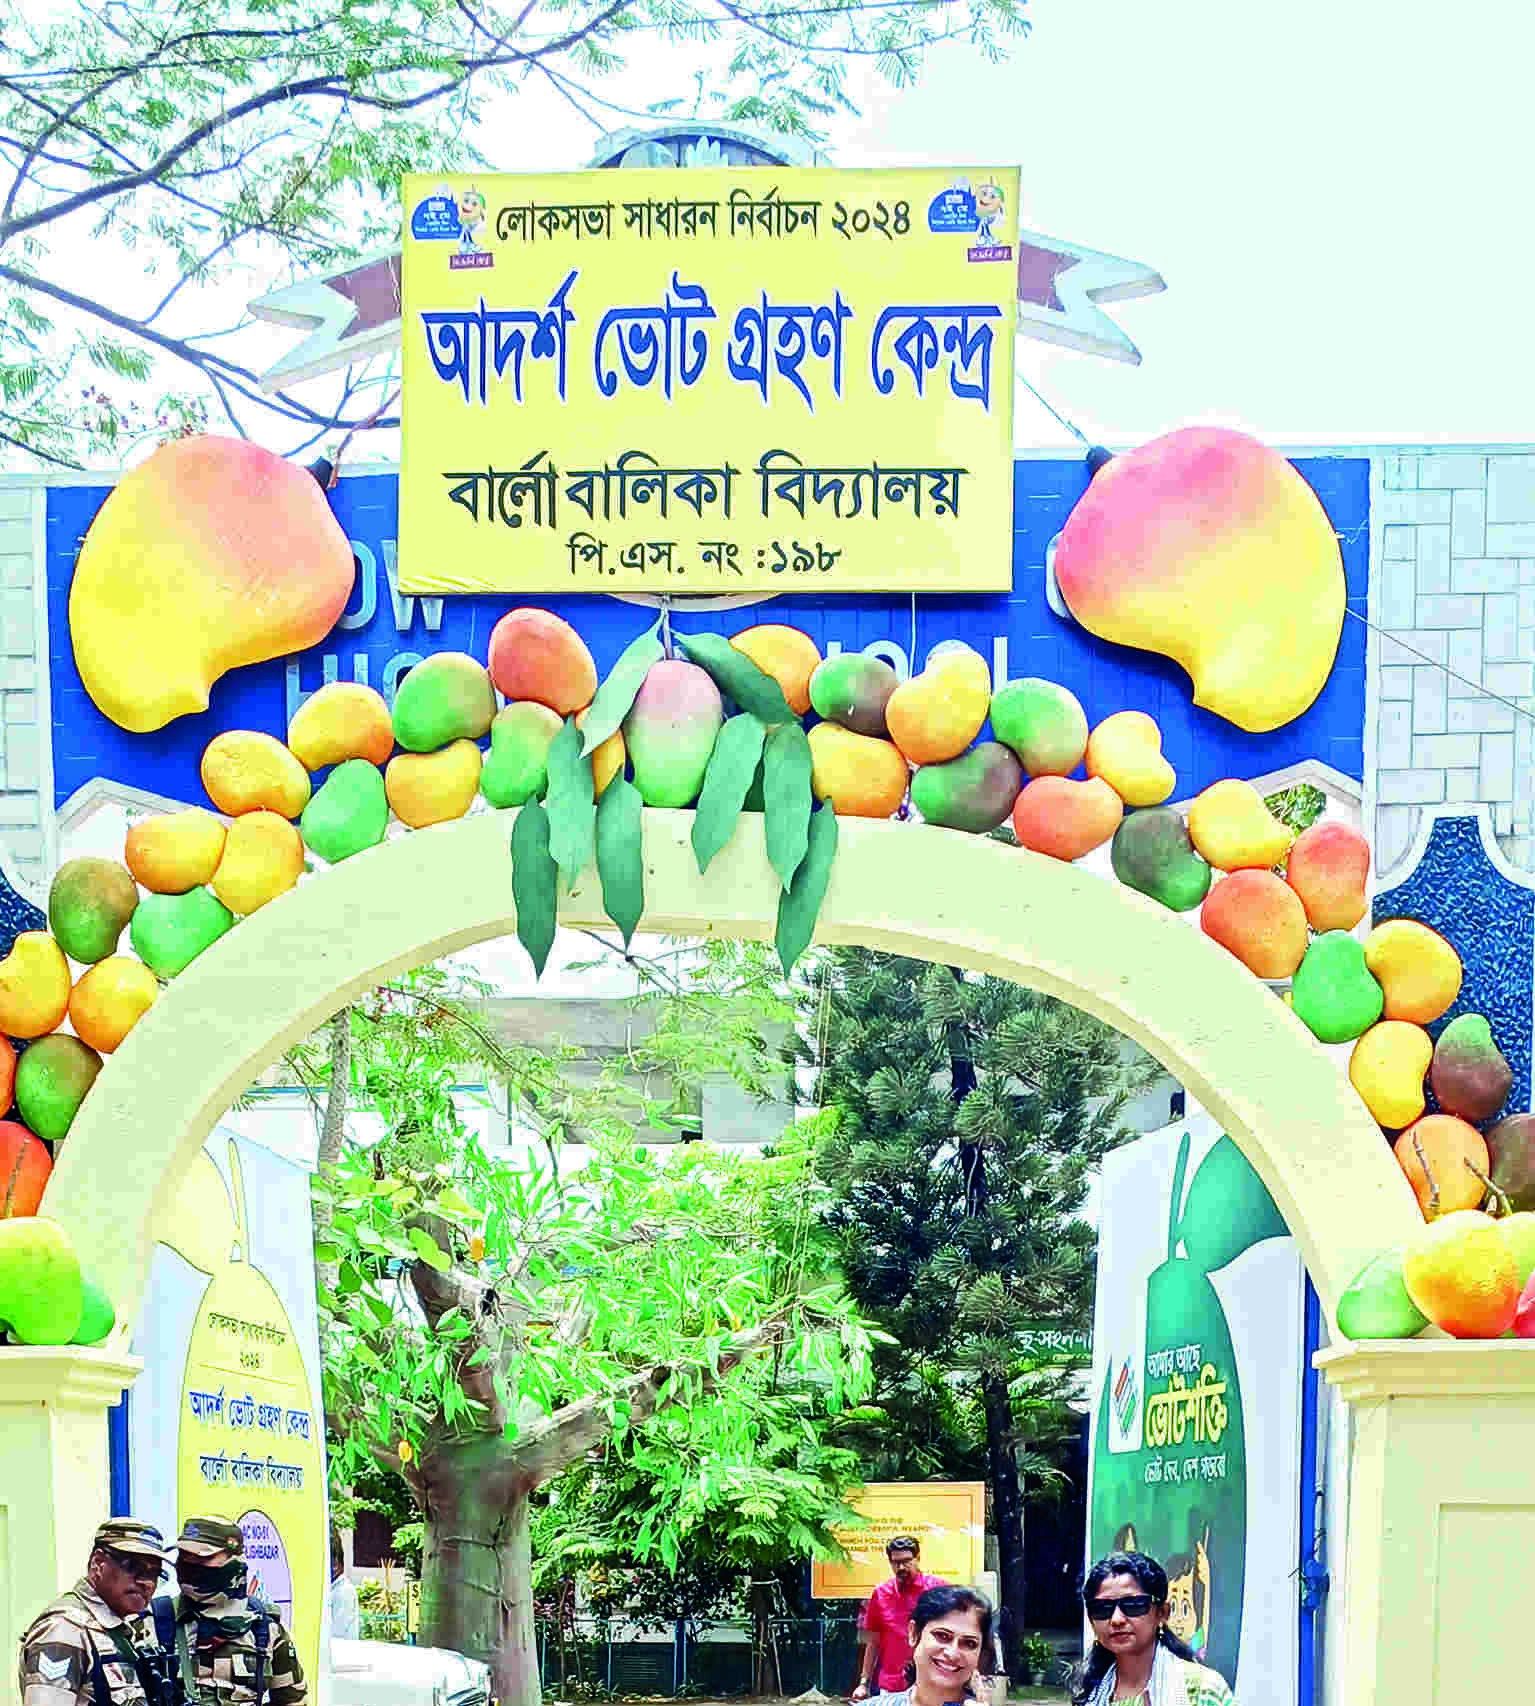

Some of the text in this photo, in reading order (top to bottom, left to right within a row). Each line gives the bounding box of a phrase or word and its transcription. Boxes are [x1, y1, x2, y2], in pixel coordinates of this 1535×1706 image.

[496, 199, 616, 241] লোকসভা
[621, 198, 718, 241] সাধারন
[727, 187, 823, 239] নির্বাচন
[831, 200, 911, 240] ২০২৪
[420, 269, 1002, 412] আদর্শ ভোট গ্রহণ কেন্দ্র
[442, 449, 970, 530] বার্লো বালিকা বিদ্যালয়
[698, 541, 741, 575] নং
[189, 1384, 224, 1424] আদর্শ
[230, 1394, 254, 1427] ভোট
